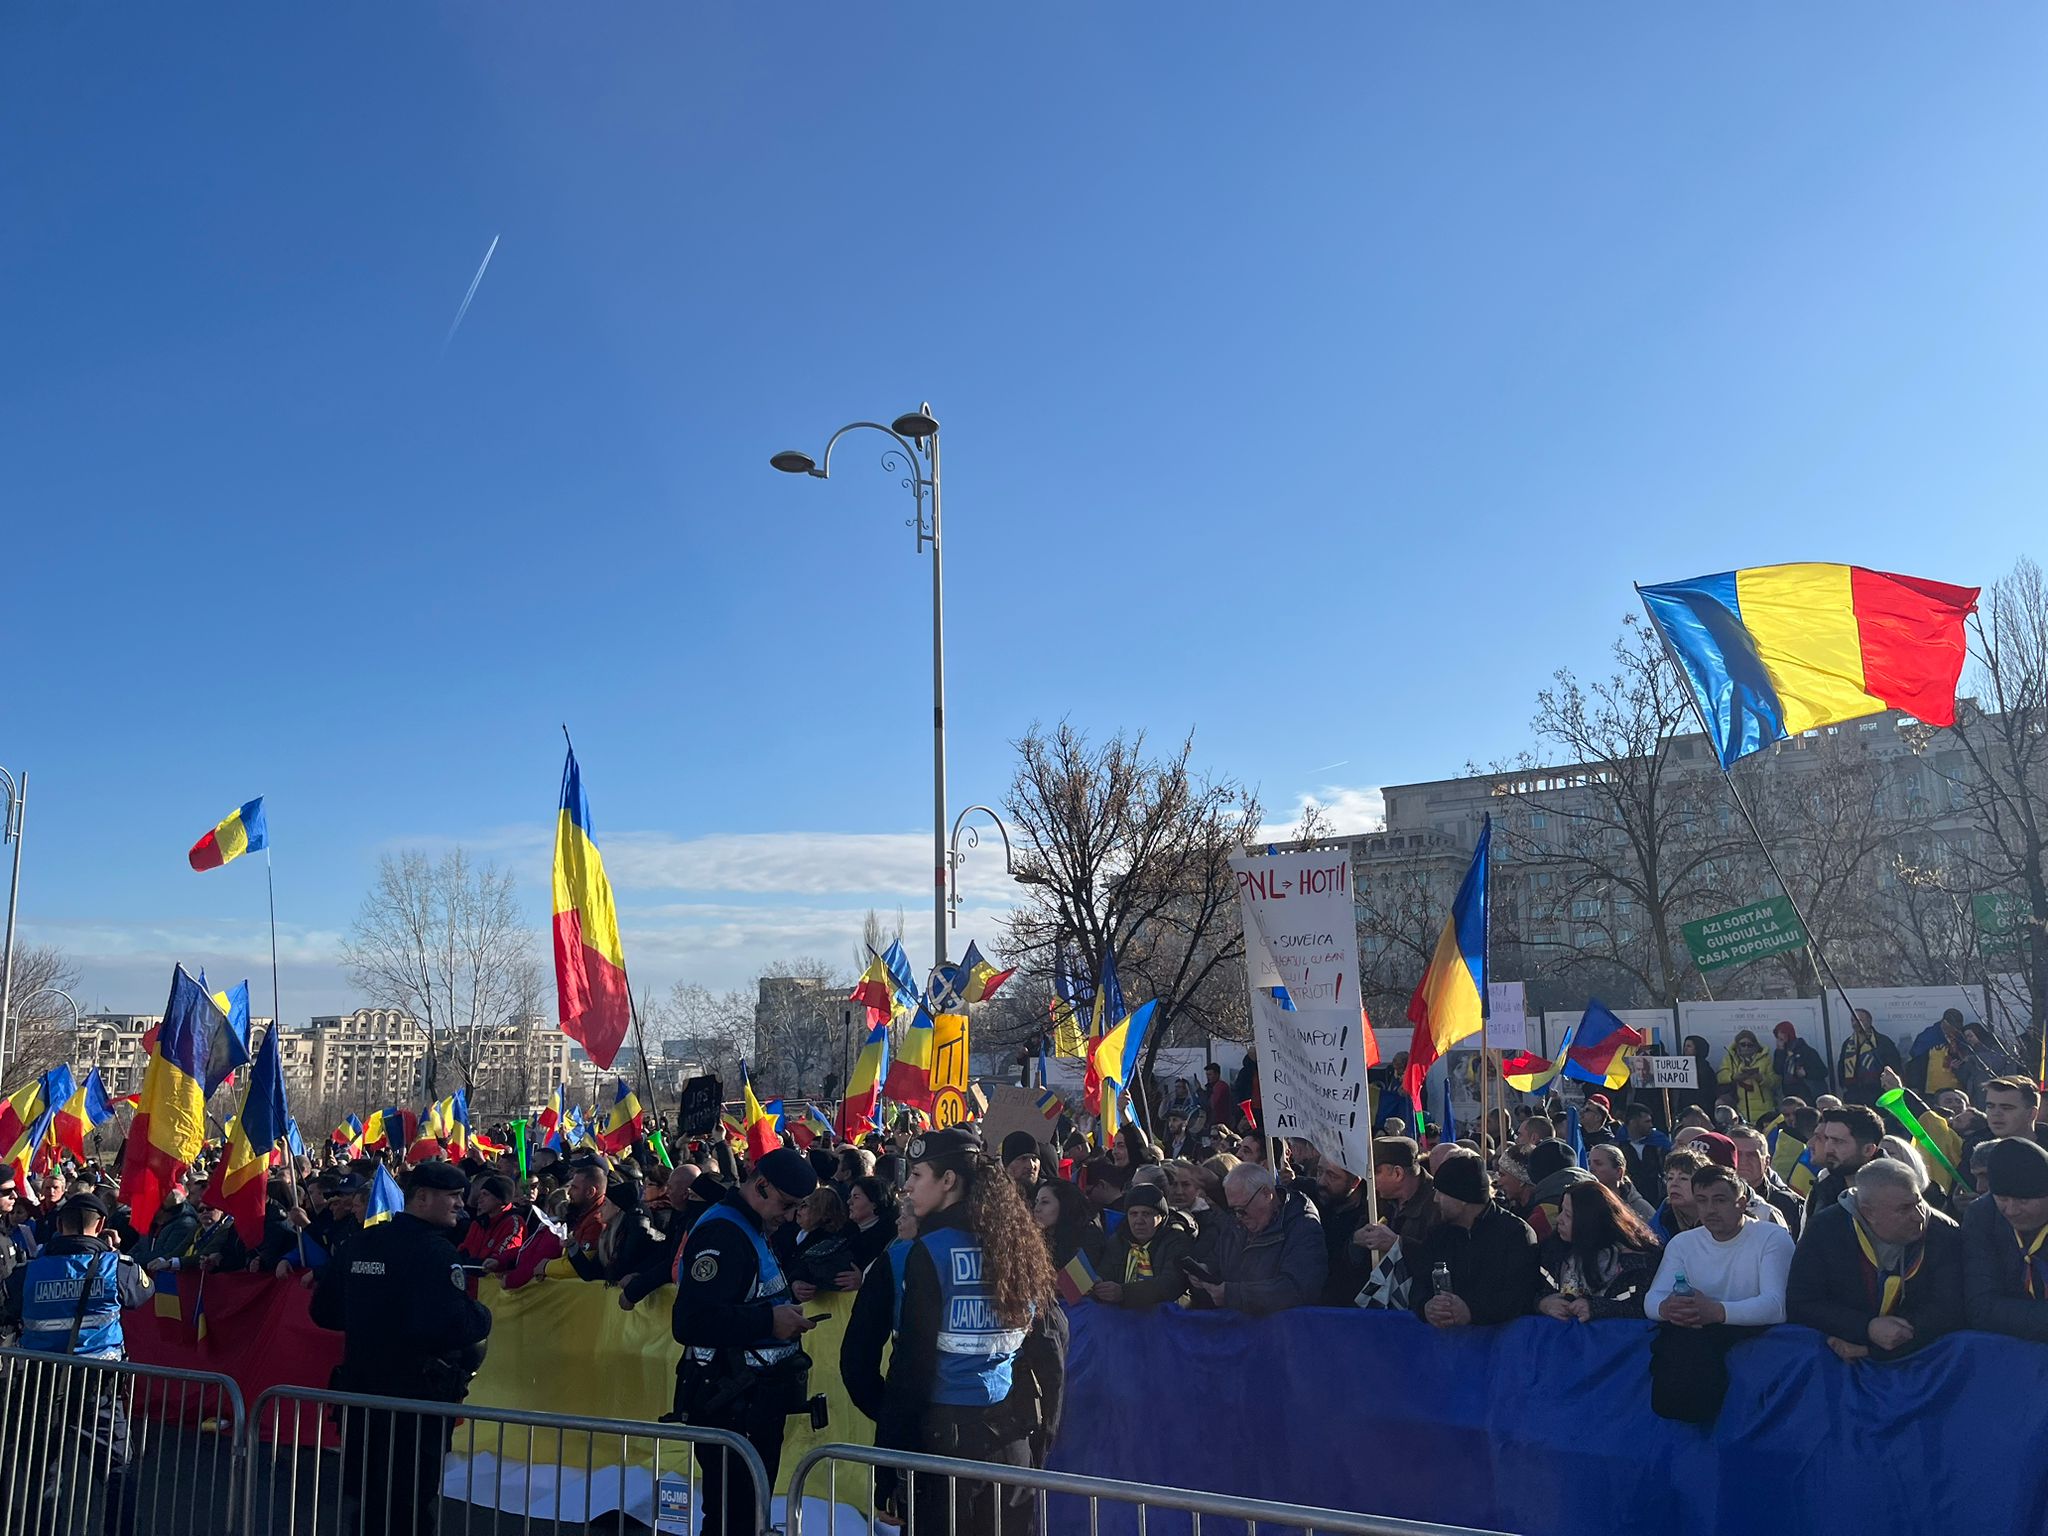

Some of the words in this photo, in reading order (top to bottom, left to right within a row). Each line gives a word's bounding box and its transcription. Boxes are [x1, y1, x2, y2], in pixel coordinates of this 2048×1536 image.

[1236, 868, 1286, 901] PNL
[1702, 922, 1721, 936] AZI
[1706, 927, 1761, 949] GUNOIUL
[1763, 921, 1780, 933] LA
[1280, 932, 1334, 948] SUVEICA
[1697, 951, 1730, 966] CASA
[1732, 930, 1800, 957] POPORULUI
[1655, 1059, 1681, 1070] TURUL
[1682, 1058, 1690, 1072] 2
[1657, 1072, 1689, 1084] INAPOI
[941, 1099, 958, 1126] 30
[661, 1489, 688, 1504] DGJMB
